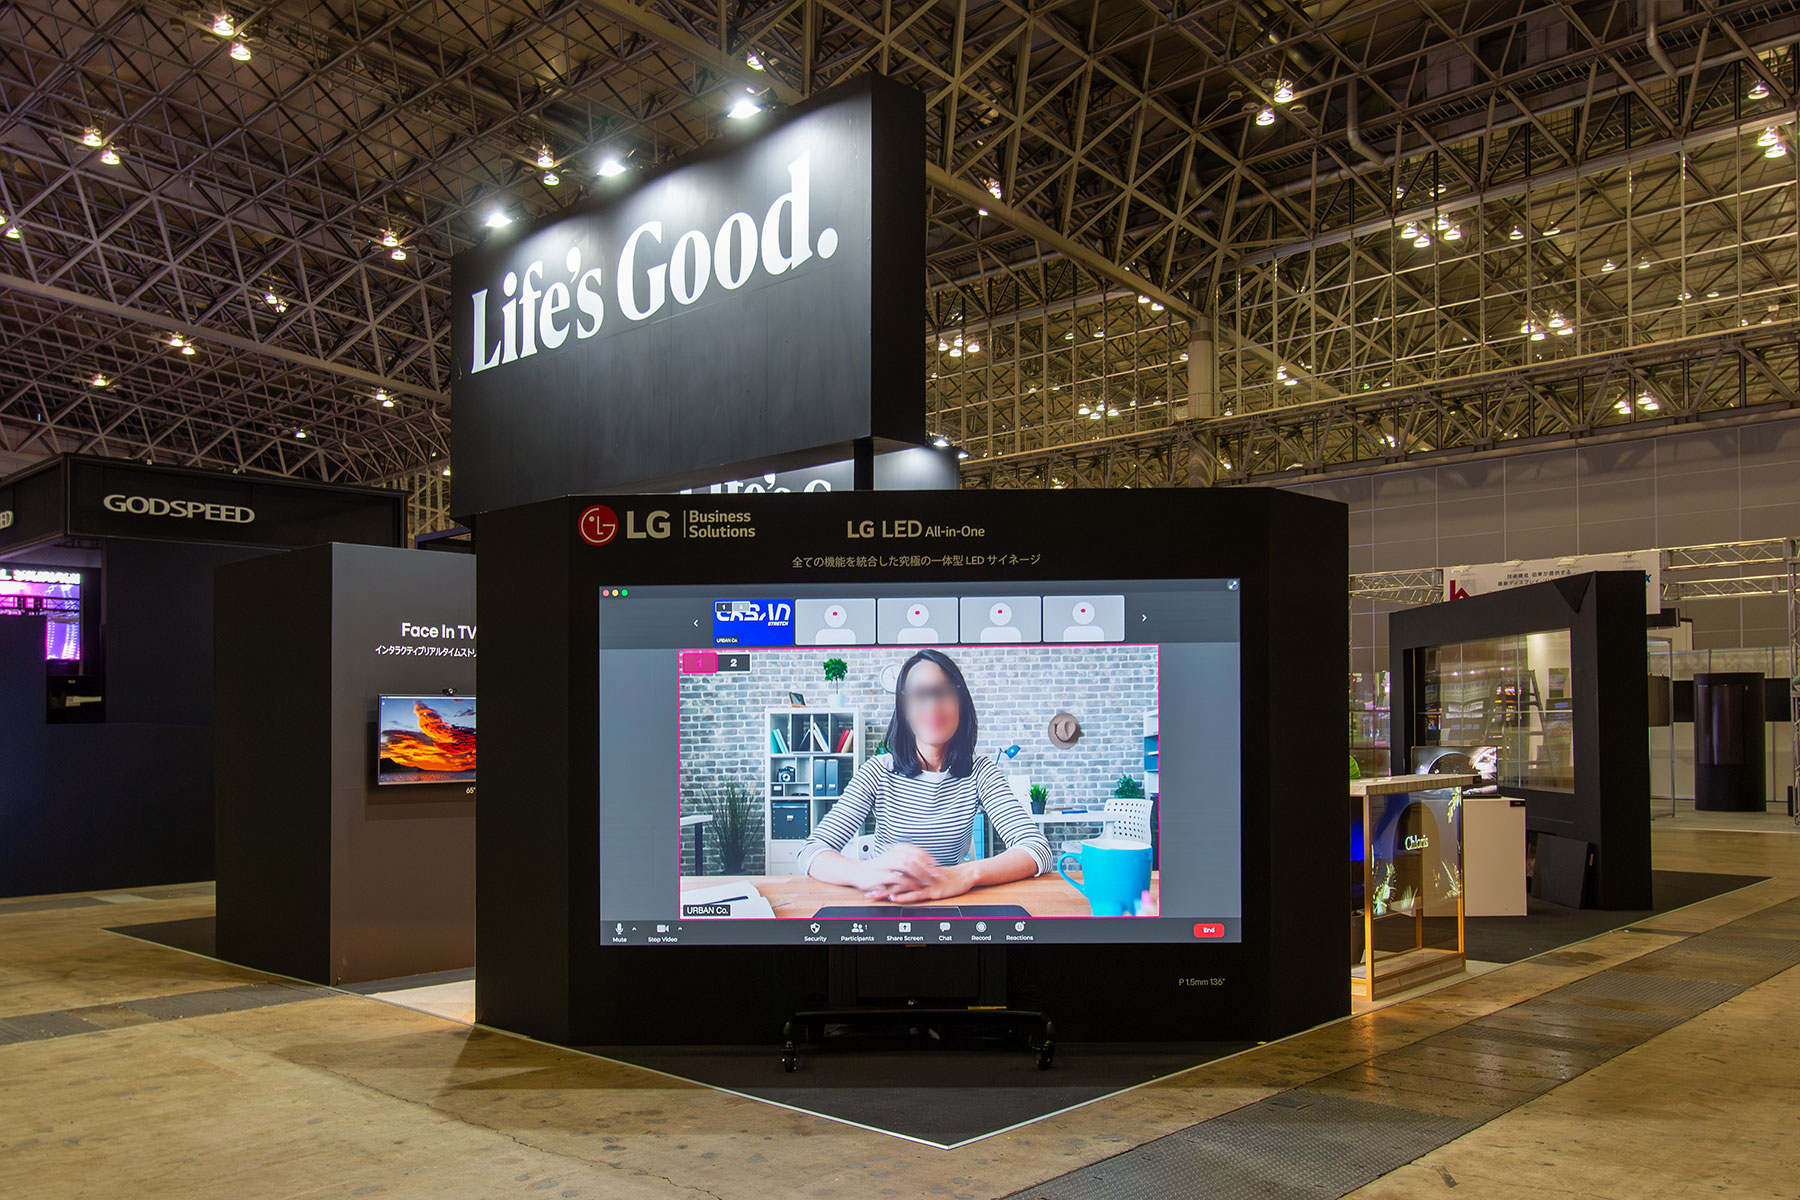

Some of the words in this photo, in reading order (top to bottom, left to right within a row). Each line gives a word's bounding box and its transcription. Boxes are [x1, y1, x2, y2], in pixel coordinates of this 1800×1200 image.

[471, 246, 605, 374] Life’s
[616, 149, 839, 322] Good.
[103, 494, 256, 524] GODSPEED
[689, 509, 751, 523] Business
[626, 510, 671, 539] LG
[689, 524, 756, 538] Solutions
[847, 520, 875, 539] LG
[882, 519, 923, 538] LED
[925, 525, 986, 538] All-in-One
[966, 555, 985, 566] LED
[987, 553, 1041, 566] サイネージ
[401, 622, 439, 638] Face
[441, 624, 455, 639] In
[457, 625, 477, 640] TV
[730, 658, 738, 668] 2
[1405, 834, 1429, 851] Chloris
[686, 906, 715, 915] URBAN
[716, 906, 729, 915] Co.
[804, 935, 827, 943] Security
[840, 935, 875, 943] Participants
[1178, 978, 1185, 986] P
